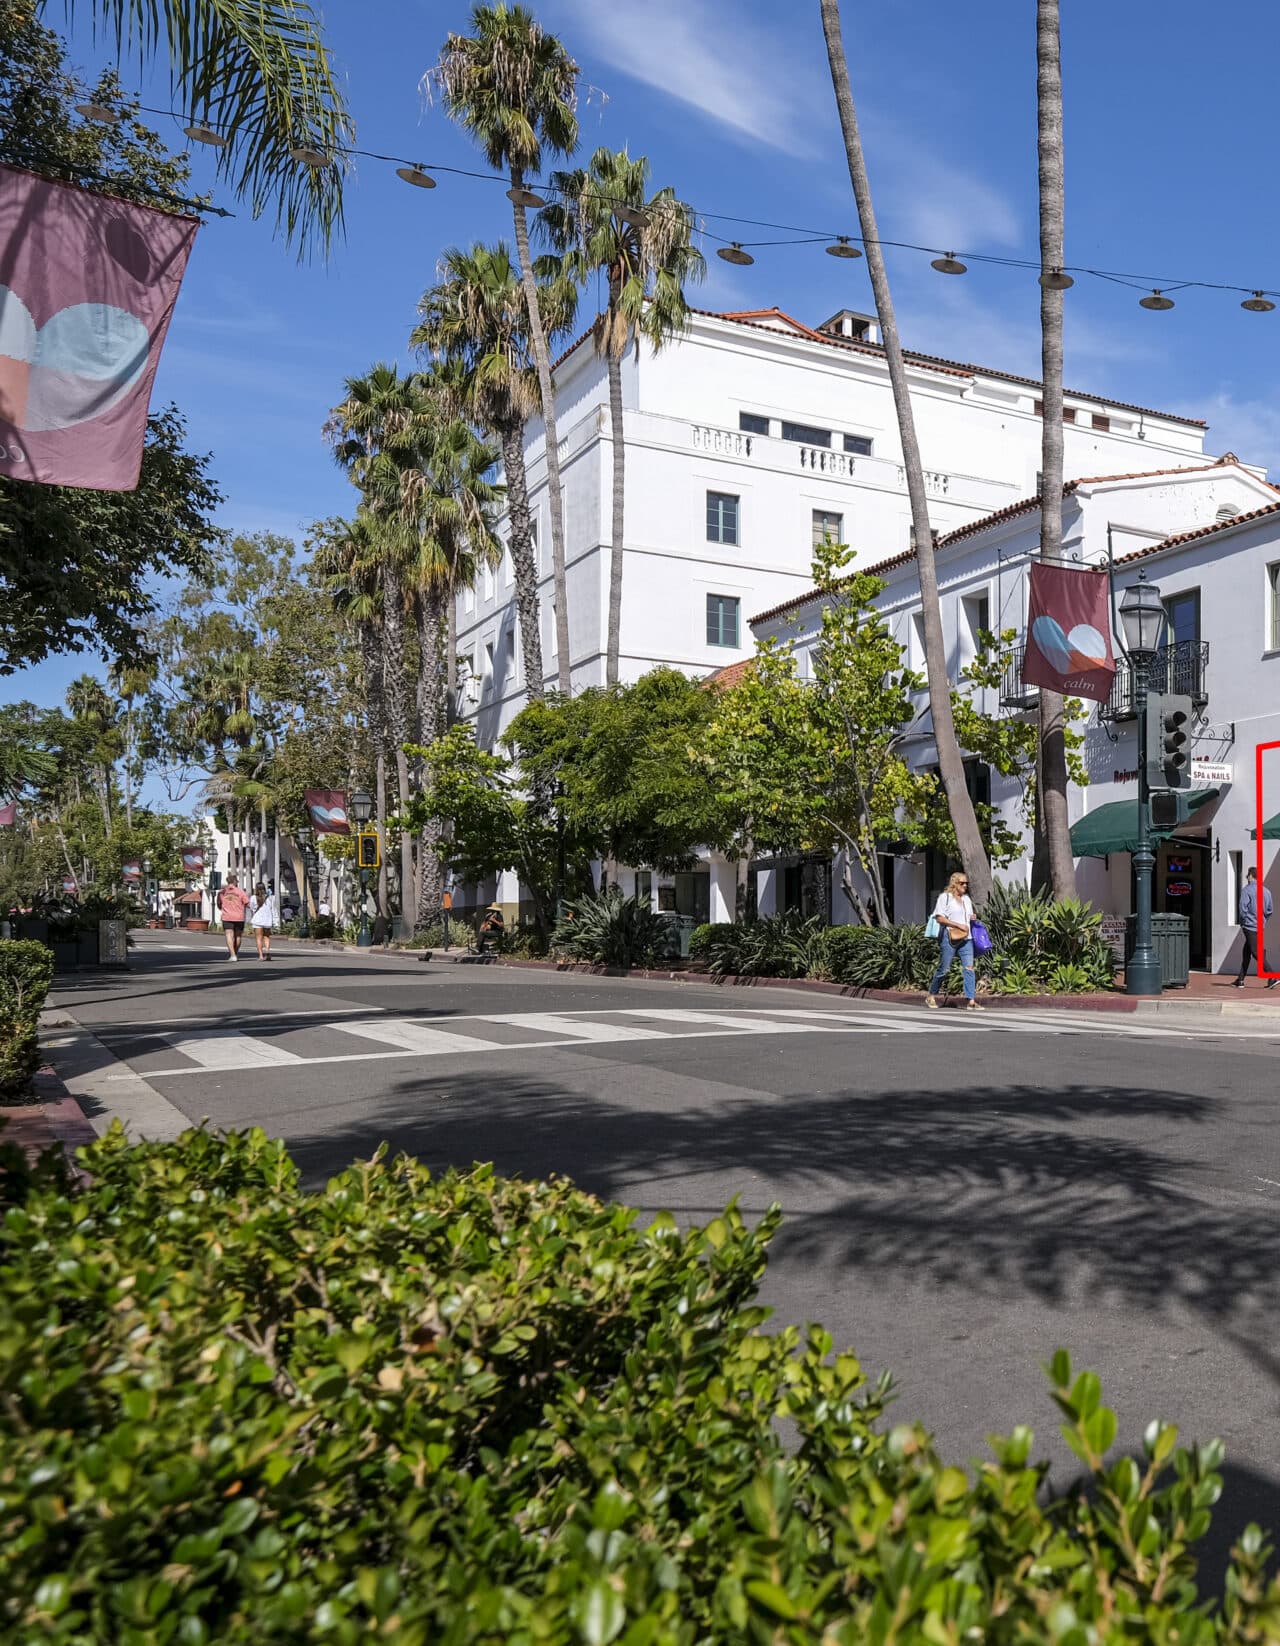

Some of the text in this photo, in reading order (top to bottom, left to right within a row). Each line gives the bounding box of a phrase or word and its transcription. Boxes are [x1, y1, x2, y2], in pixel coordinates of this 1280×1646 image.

[1063, 679, 1095, 692] calm
[1193, 771, 1206, 779] SPA
[1211, 772, 1231, 781] NAILS
